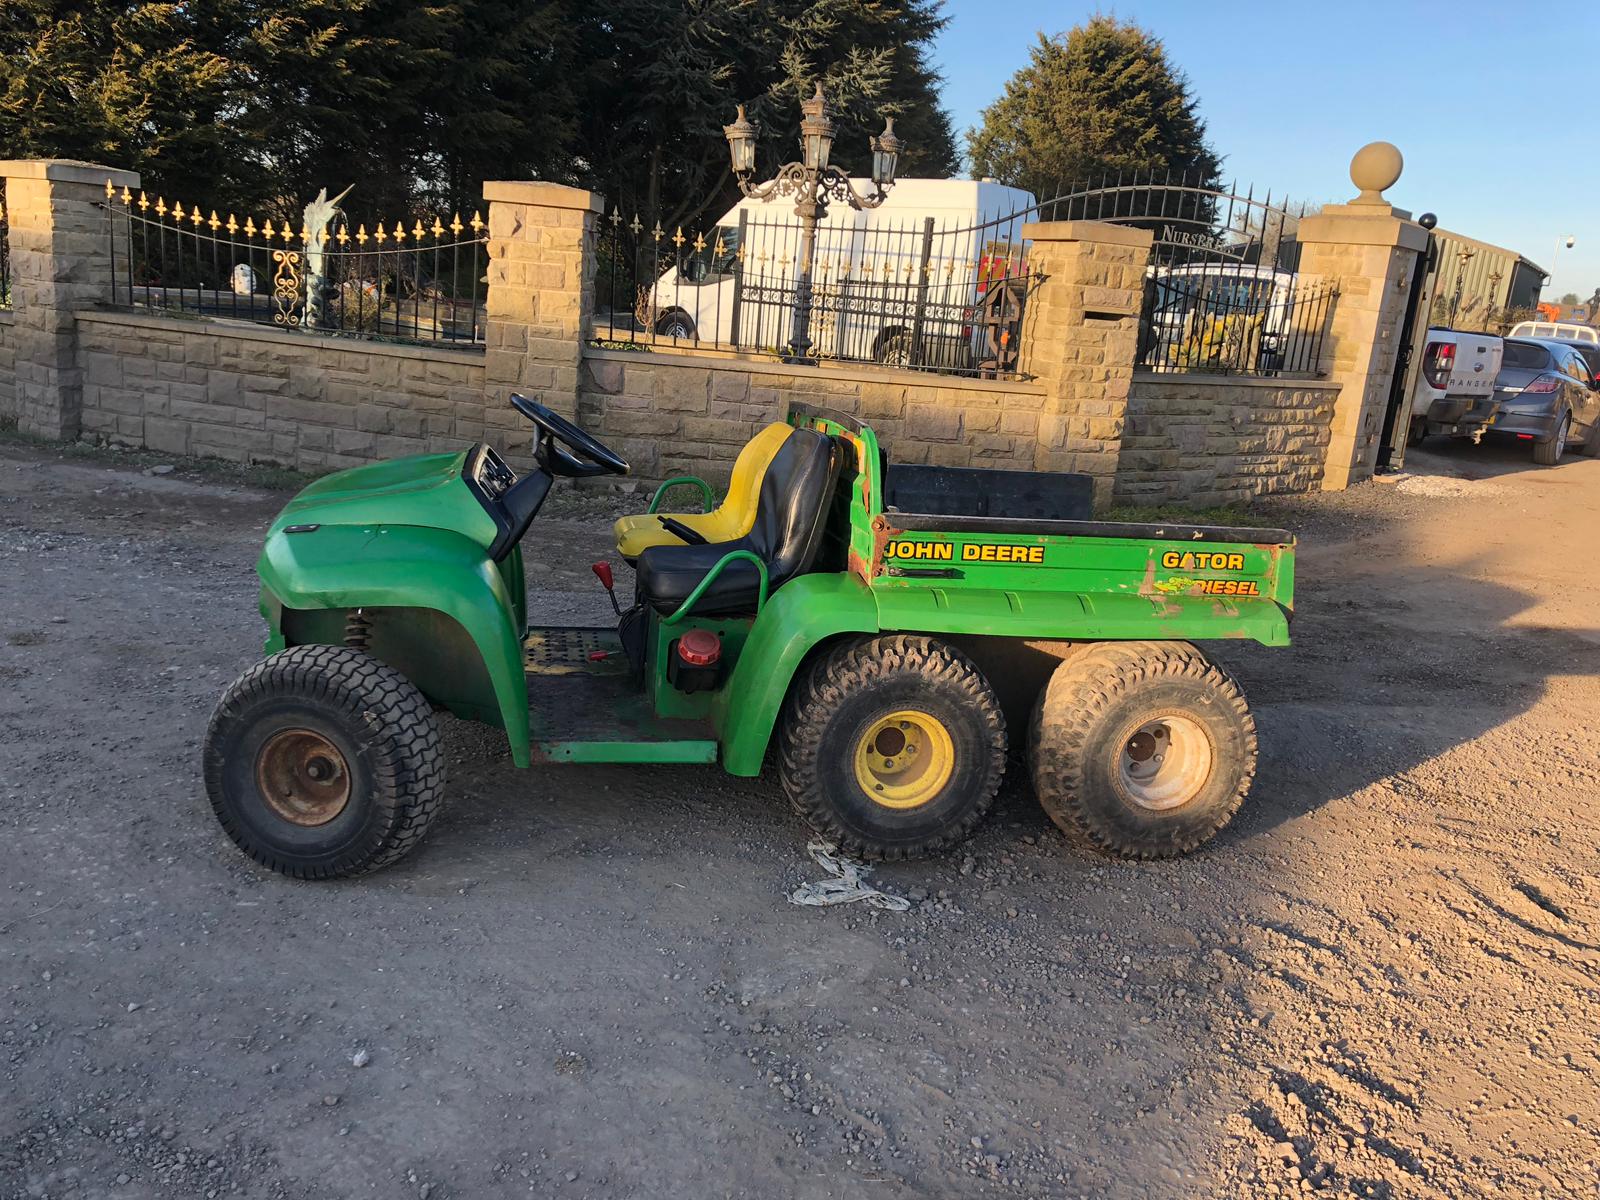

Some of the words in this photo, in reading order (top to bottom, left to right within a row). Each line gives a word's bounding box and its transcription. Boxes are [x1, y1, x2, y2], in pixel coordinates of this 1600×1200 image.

[1450, 378, 1494, 387] RANGER
[884, 541, 953, 560] JOHN
[962, 543, 1045, 563] DEERE
[1162, 551, 1244, 570] GATOR
